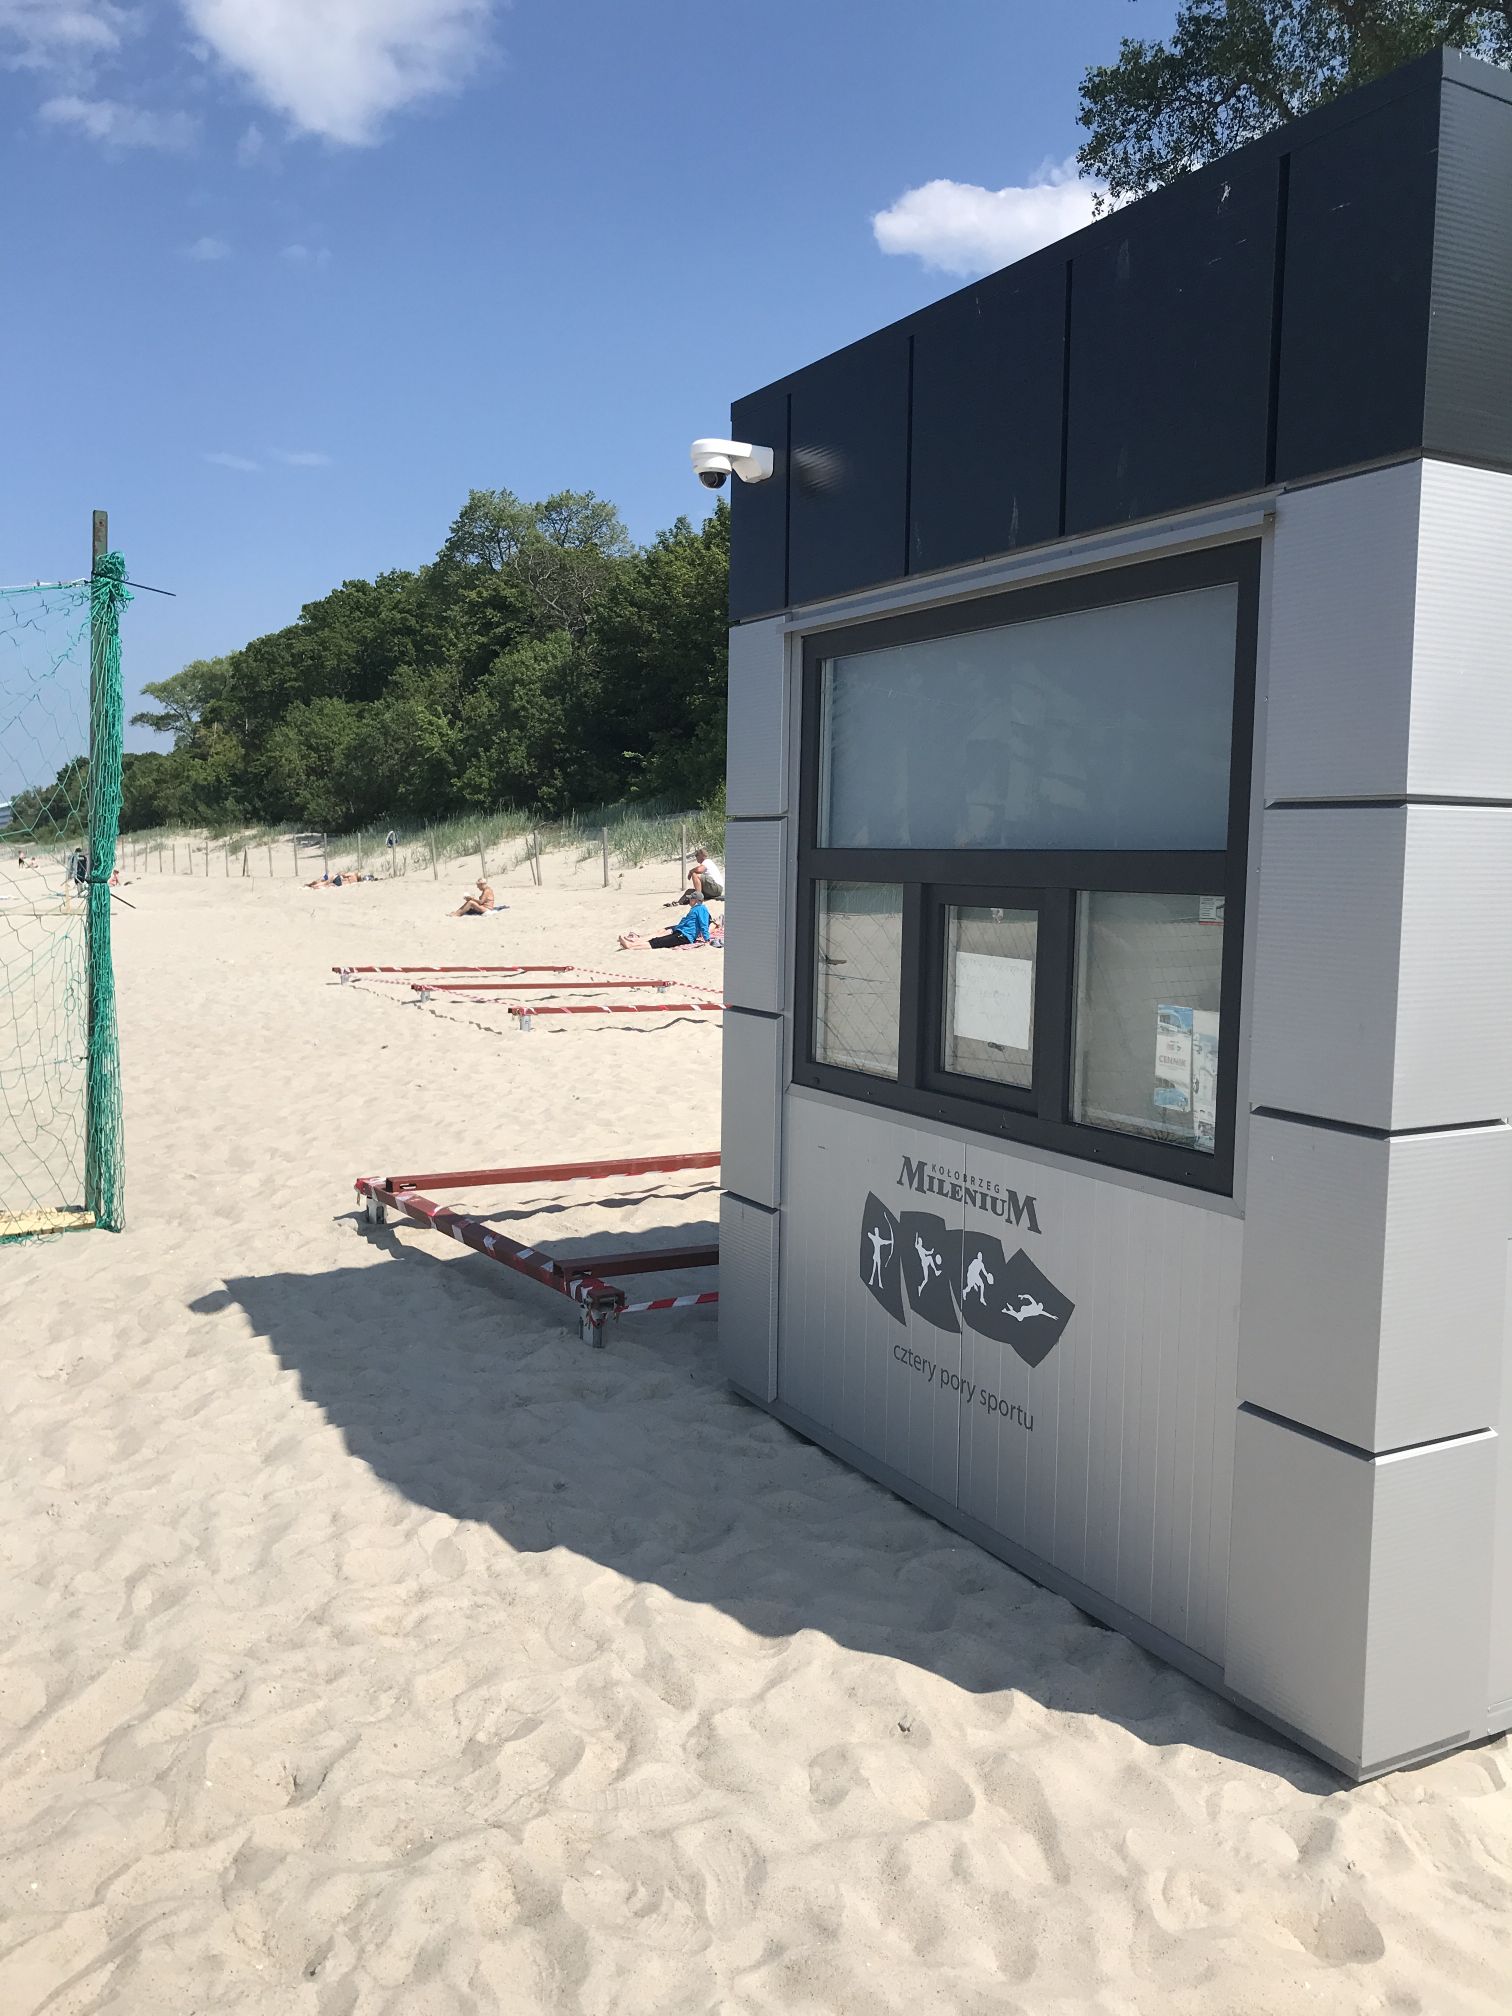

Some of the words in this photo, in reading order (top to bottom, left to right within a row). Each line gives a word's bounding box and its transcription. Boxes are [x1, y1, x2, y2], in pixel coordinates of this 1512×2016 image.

[896, 1155, 1042, 1234] MILENIUM
[931, 1163, 1001, 1194] KOŁOBRZEG
[893, 1343, 937, 1383] cztery
[940, 1367, 976, 1403] pory
[979, 1388, 1034, 1432] sportu
